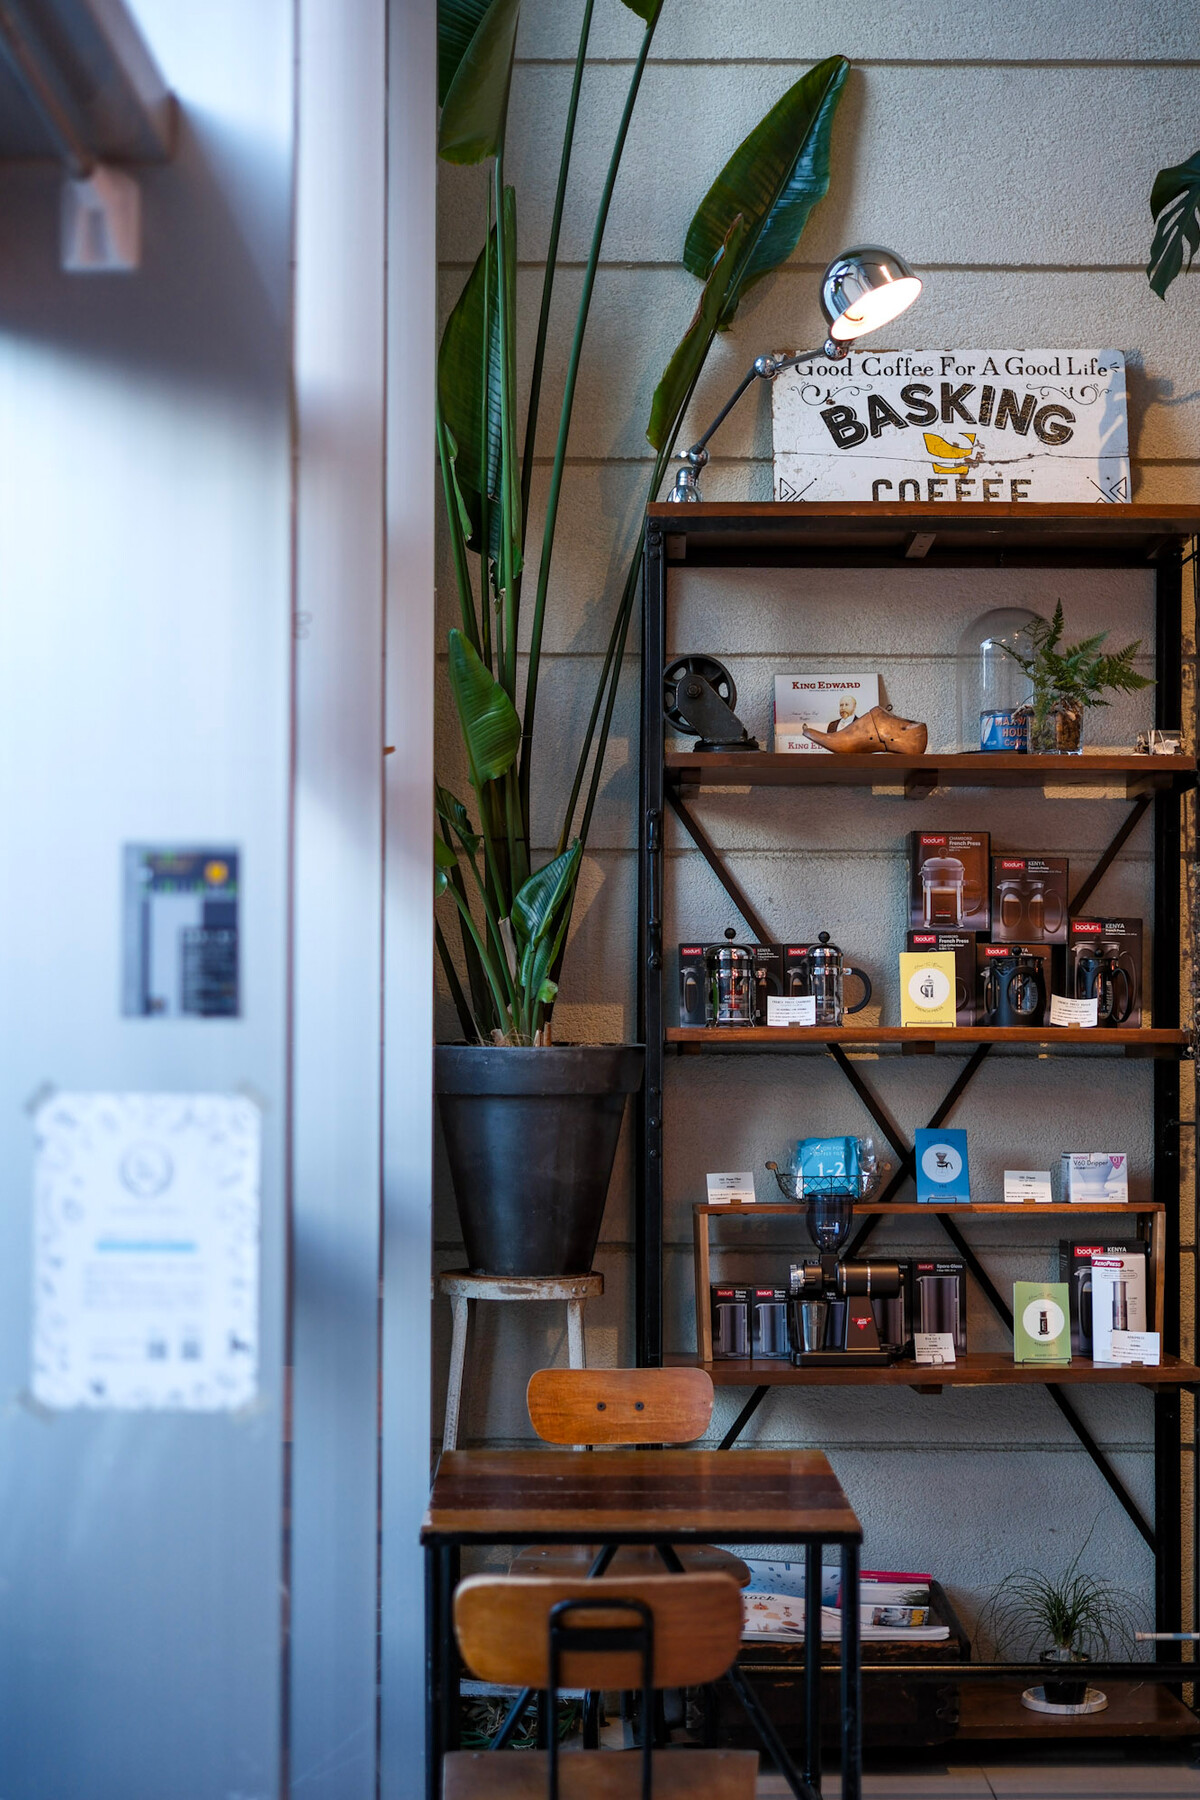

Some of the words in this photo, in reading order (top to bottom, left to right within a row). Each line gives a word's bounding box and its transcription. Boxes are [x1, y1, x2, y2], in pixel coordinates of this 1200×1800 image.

[794, 357, 854, 376] Good
[861, 356, 934, 377] Coffee
[939, 356, 976, 376] For
[979, 356, 1001, 376] A
[1004, 356, 1062, 376] Good
[1066, 356, 1108, 377] Life
[819, 382, 1077, 450] BASKING
[871, 478, 1032, 502] COFFEE
[791, 681, 816, 690] KING
[817, 681, 861, 689] EDWARD
[1075, 923, 1100, 931] bodum
[817, 1162, 846, 1177] 1-2
[1086, 1159, 1108, 1168] Dripper
